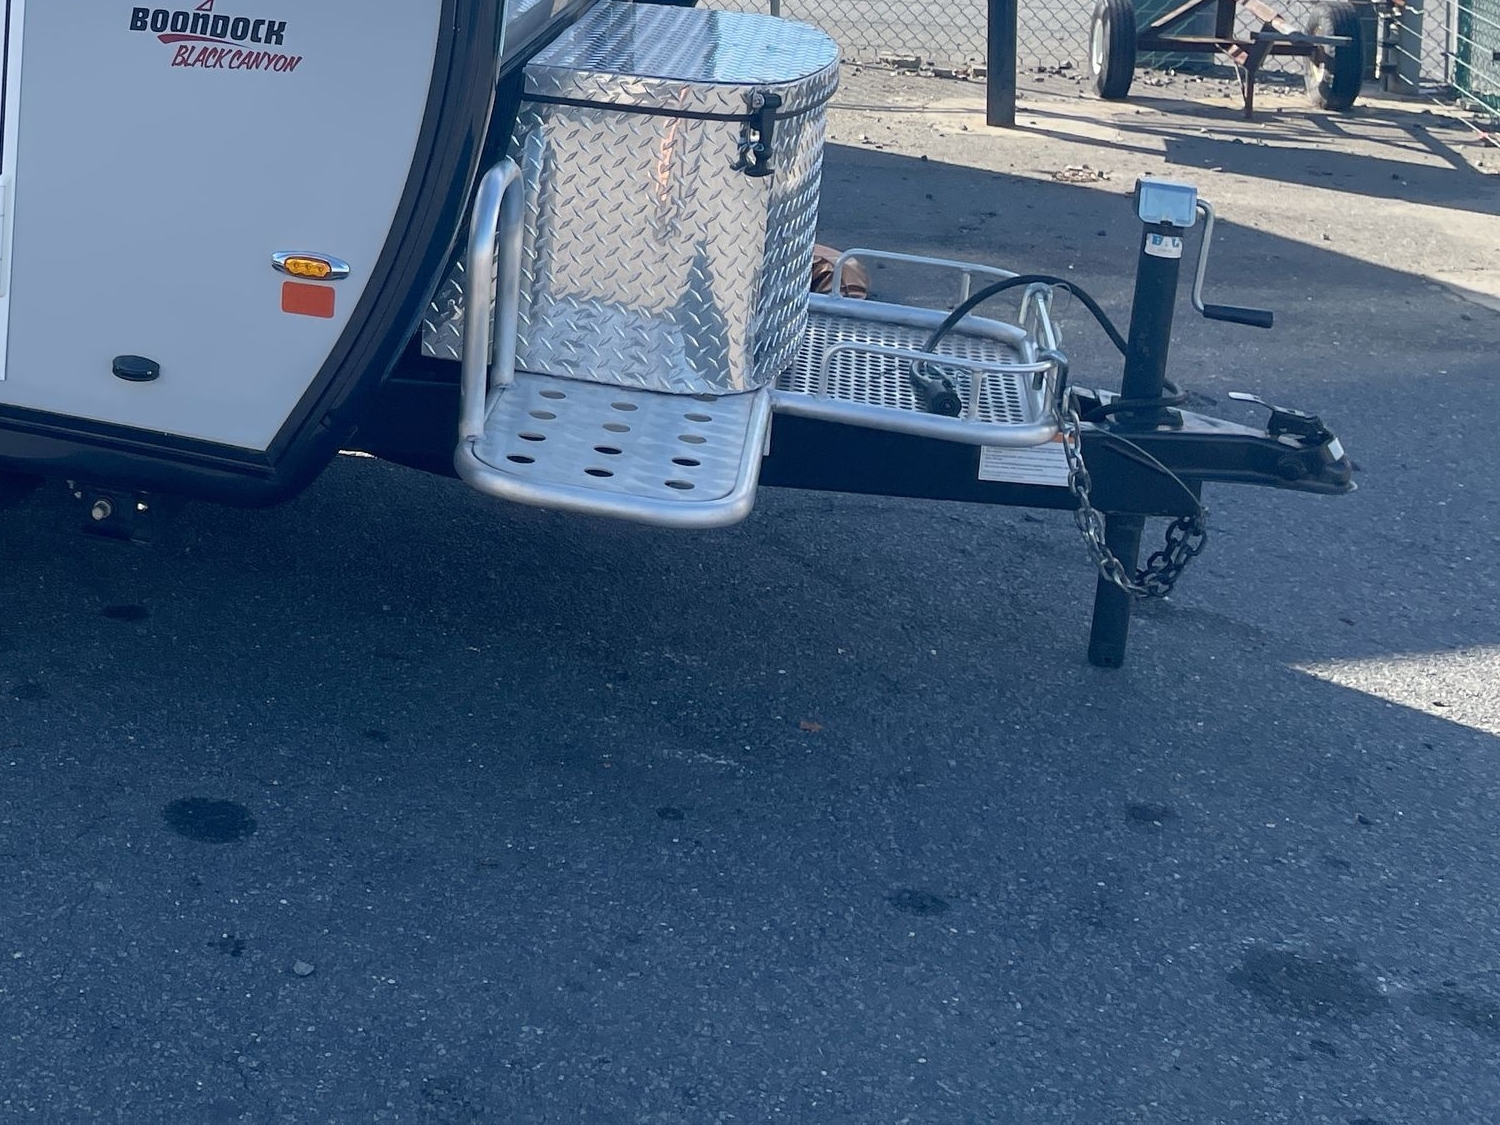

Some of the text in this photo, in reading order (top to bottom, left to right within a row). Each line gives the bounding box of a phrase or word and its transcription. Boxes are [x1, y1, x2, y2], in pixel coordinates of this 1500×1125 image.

[129, 6, 287, 46] BOONDOCK
[172, 44, 303, 73] BLACK CANYON
